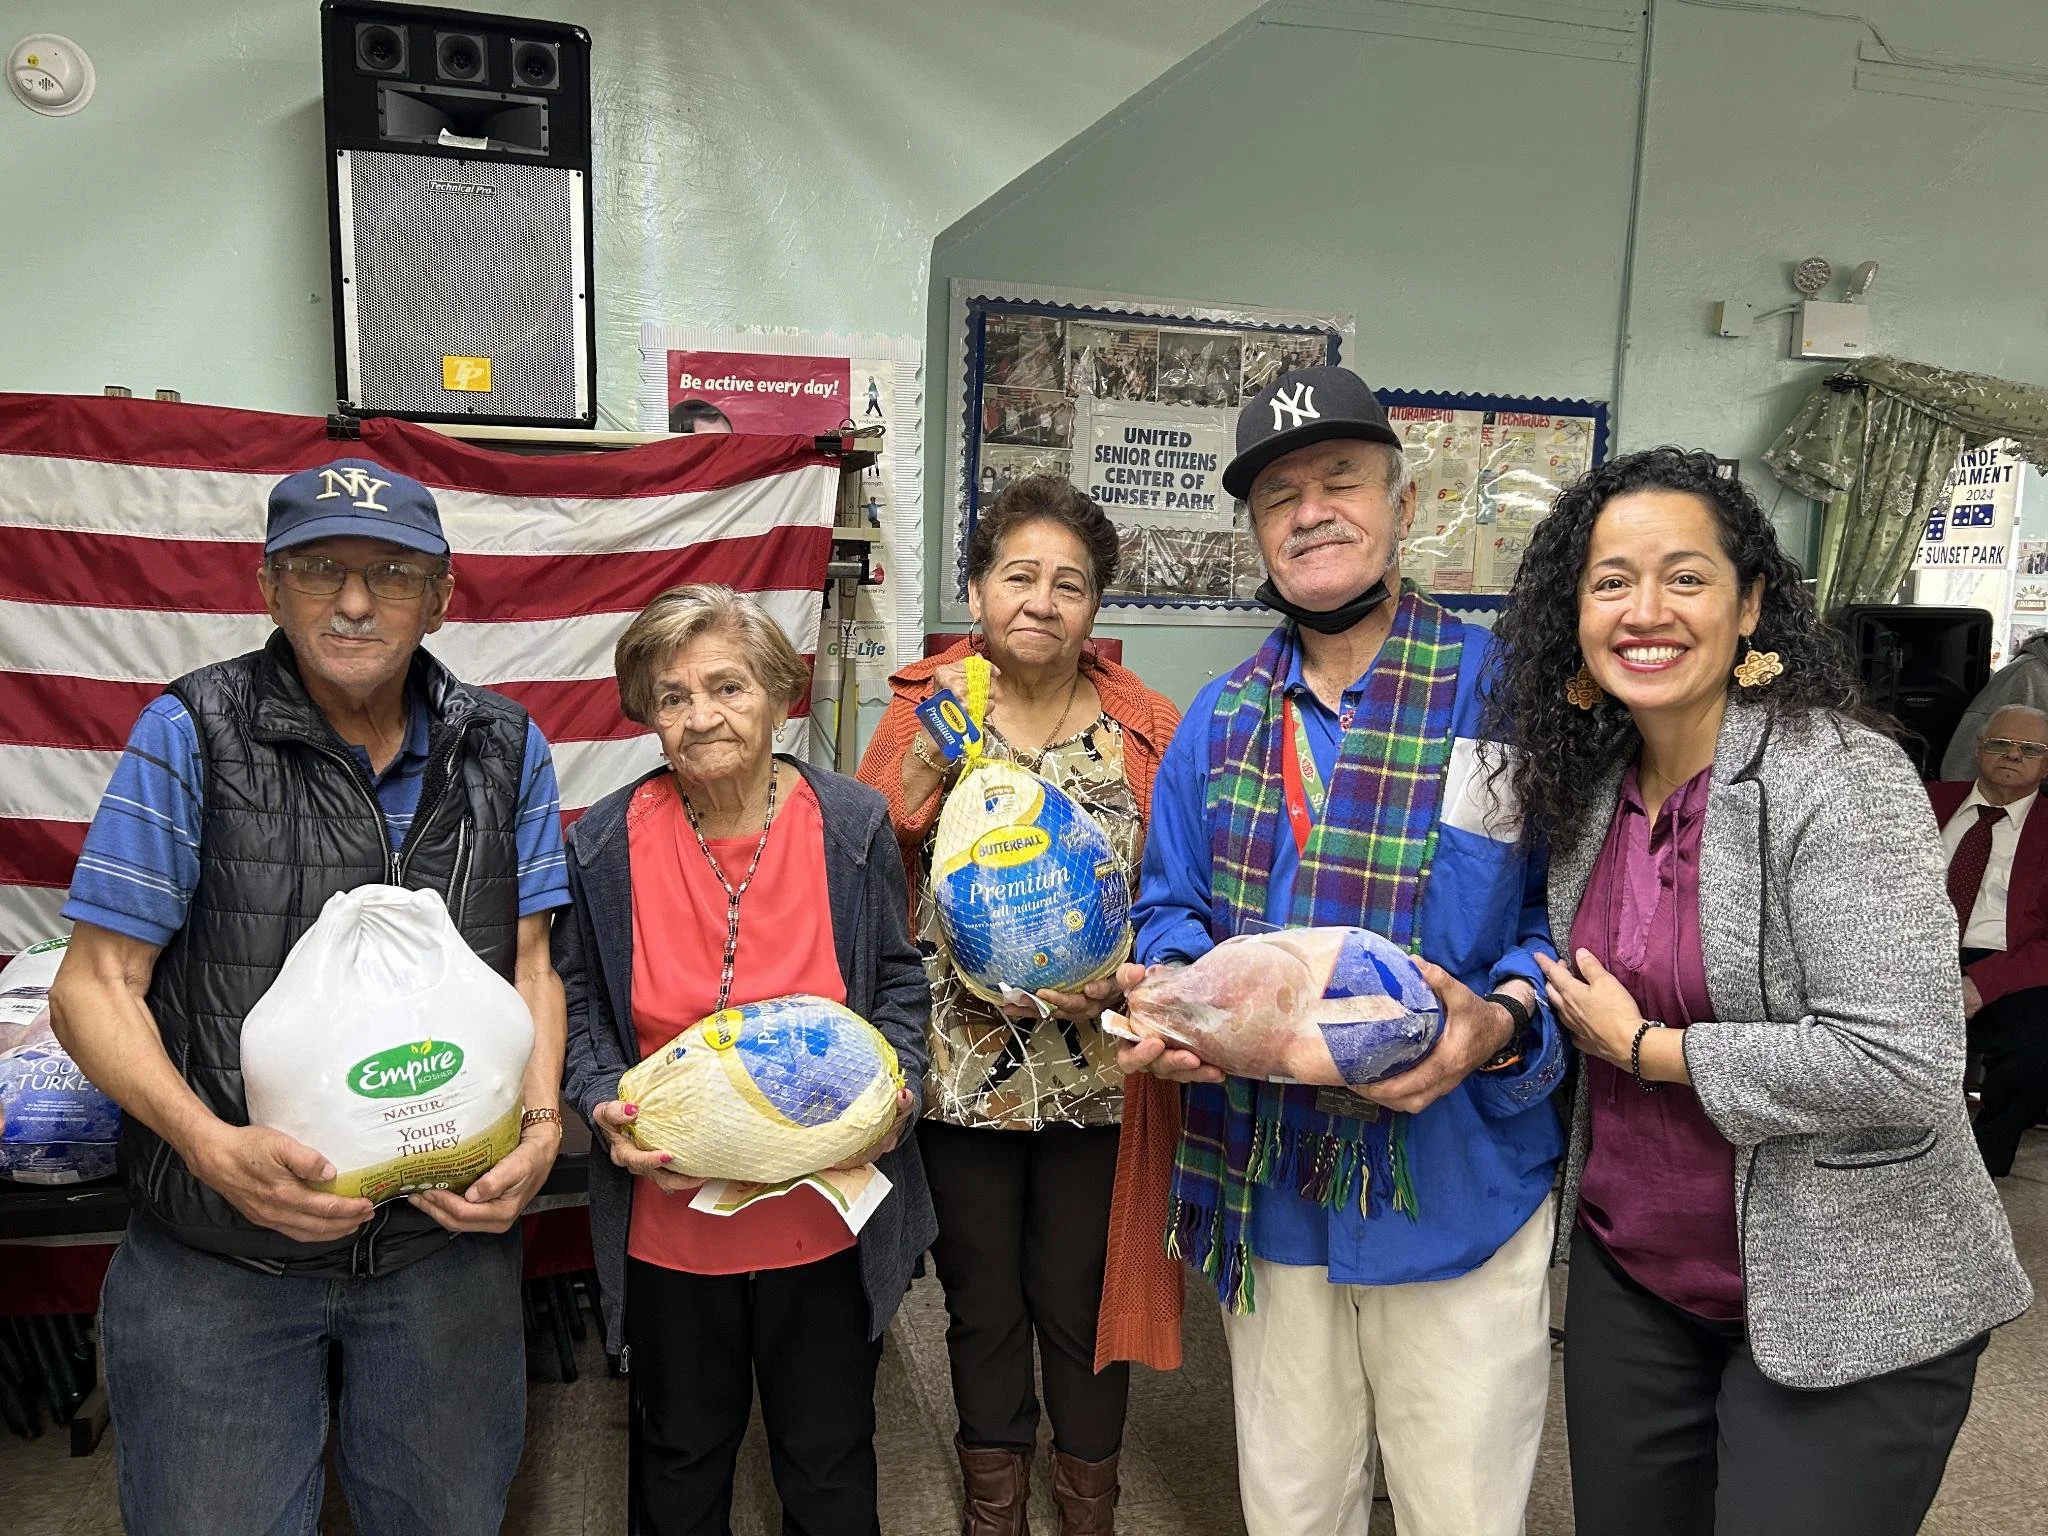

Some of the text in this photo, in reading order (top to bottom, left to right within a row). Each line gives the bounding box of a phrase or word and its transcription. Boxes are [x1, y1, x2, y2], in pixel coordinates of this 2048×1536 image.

[430, 182, 492, 195] Technical Pro
[680, 373, 840, 398] Be active every day!
[1269, 382, 1321, 431] NY
[1498, 411, 1550, 428] TECHNIQUES
[1554, 419, 1566, 430] 5
[1124, 427, 1192, 447] UNITED
[1443, 437, 1453, 448] 5
[1094, 444, 1217, 472] SENIOR CITIZENS
[1549, 455, 1560, 467] 6
[1105, 467, 1205, 490] CENTER OF
[316, 467, 391, 512] NY
[1090, 485, 1216, 511] SUNSET PARK
[1438, 488, 1448, 500] 6
[1966, 489, 1994, 501] 2024
[1435, 525, 1446, 536] 7
[1925, 546, 1969, 564] SUNSET
[1971, 546, 2004, 564] PARK
[926, 706, 956, 745] Premium
[942, 702, 964, 730] BUTTERBALL
[979, 834, 1043, 857] BUTTERBALL
[969, 866, 1071, 905] Premium
[992, 905, 1009, 918] all
[29, 1059, 79, 1075] YOU
[358, 1050, 456, 1091] Empire
[418, 1069, 453, 1084] KOSHER
[19, 1074, 98, 1092] TURKE
[383, 1100, 445, 1121] NATUR
[397, 1118, 456, 1142] Young
[397, 1134, 461, 1157] Turkey
[428, 1162, 455, 1171] WITHOUT
